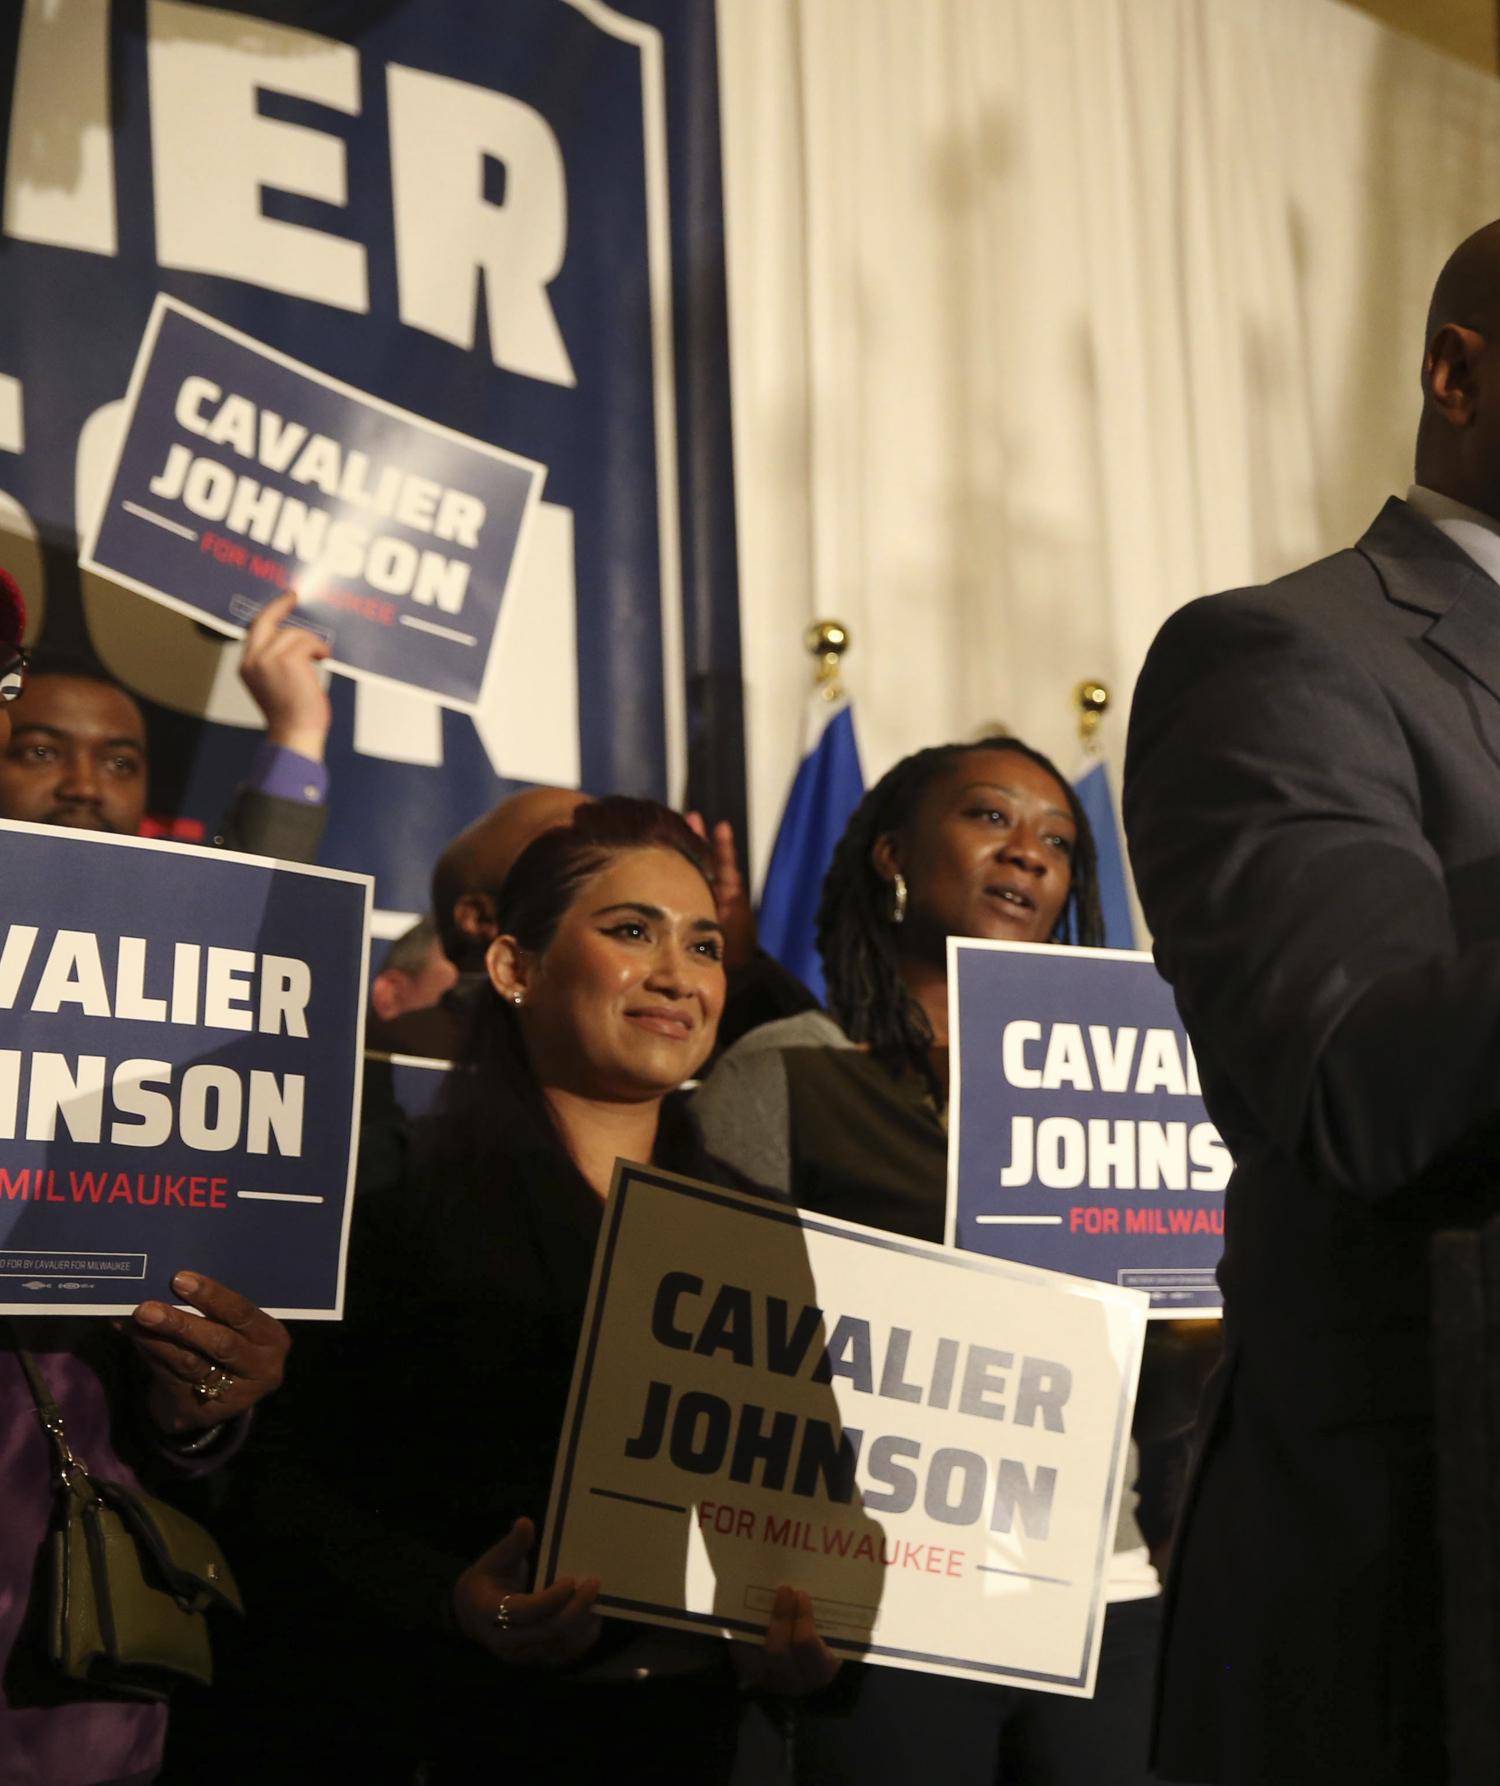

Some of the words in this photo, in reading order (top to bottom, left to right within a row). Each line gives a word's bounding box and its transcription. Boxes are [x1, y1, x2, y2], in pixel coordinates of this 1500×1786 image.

[3, 0, 577, 388] IER
[174, 375, 487, 549] CAVALIER
[149, 443, 472, 615] JOHNSON
[201, 531, 249, 568] FOR
[249, 556, 398, 627] MILUKEE
[0, 1048, 306, 1158] NSON
[1000, 1115, 1235, 1192] JOHNS
[0, 1167, 229, 1209] MILWAUKEE
[1069, 1206, 1120, 1234] FOR
[1125, 1208, 1225, 1235] MILWAU
[7, 1259, 23, 1269] FOR
[23, 1260, 34, 1270] BY
[34, 1260, 70, 1270] CAVALIER
[70, 1261, 87, 1271] FOR
[87, 1261, 131, 1272] MILWAUKEE
[651, 1271, 1073, 1435] CAVALIER
[624, 1381, 1058, 1542] JOHNSON
[699, 1501, 755, 1540] FOR
[763, 1515, 967, 1578] MILWAUKEE
